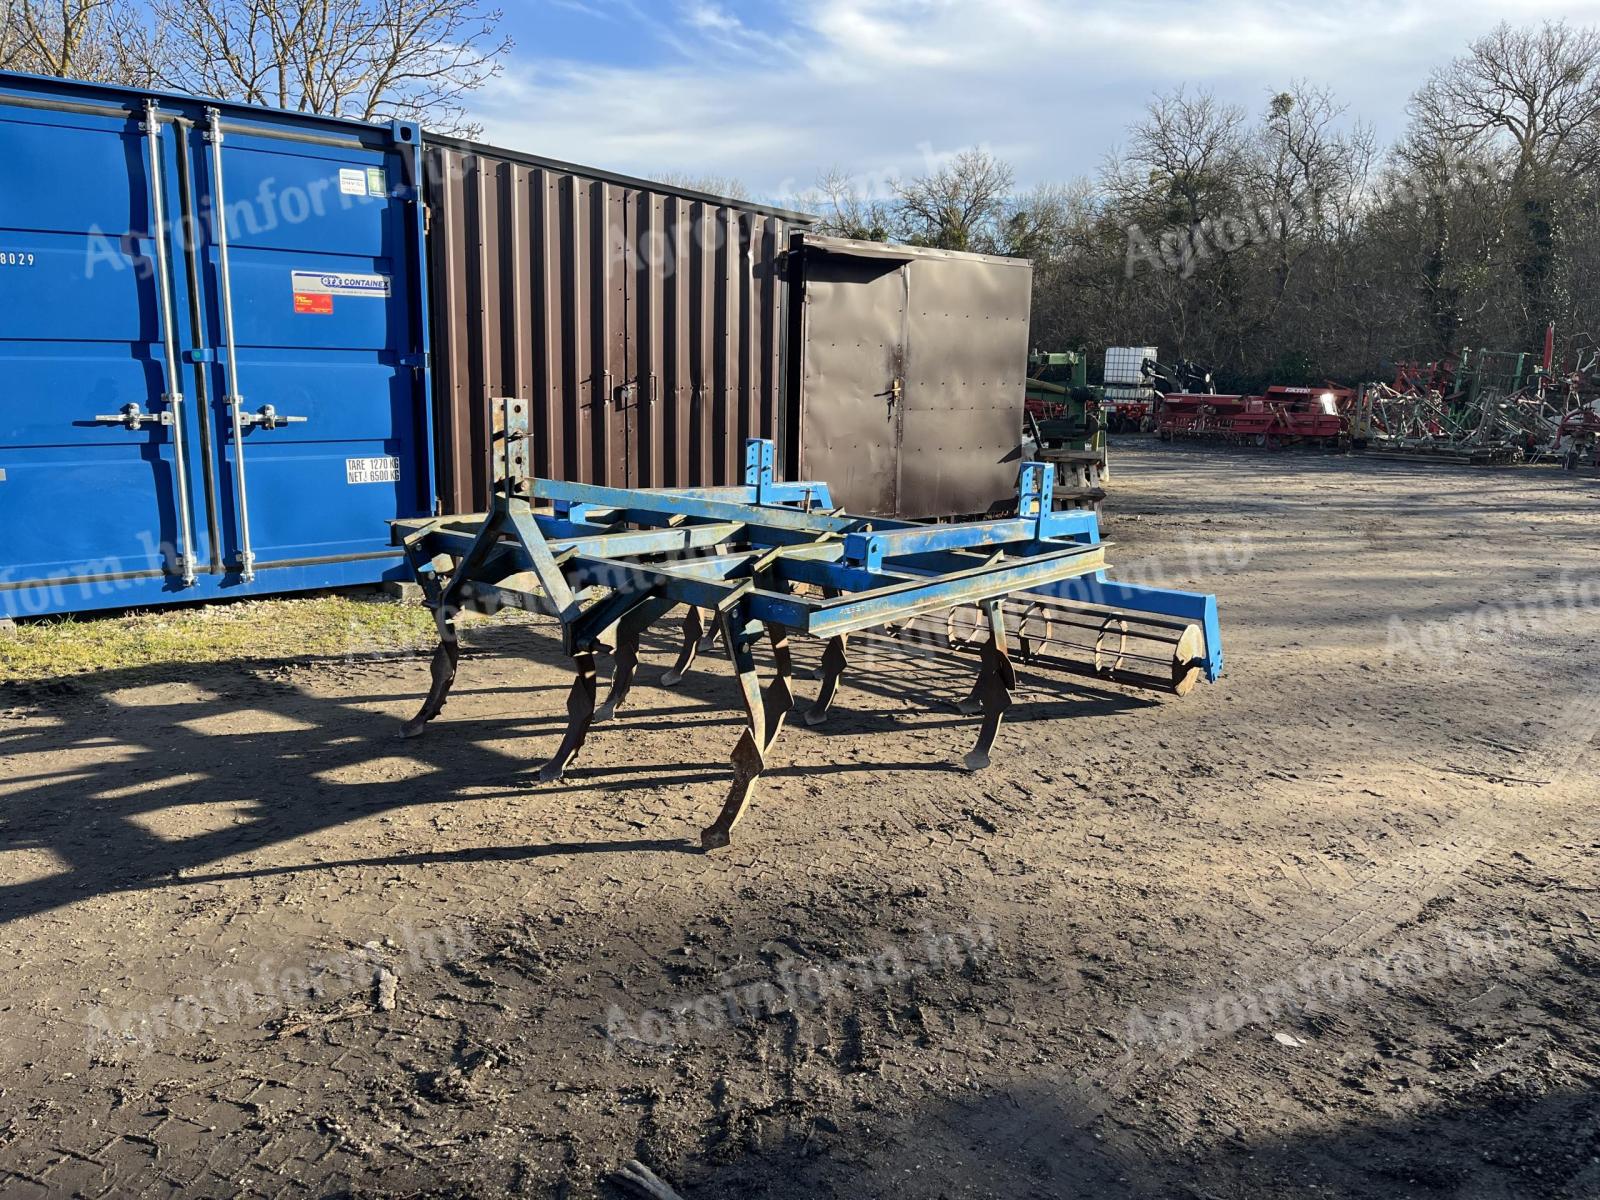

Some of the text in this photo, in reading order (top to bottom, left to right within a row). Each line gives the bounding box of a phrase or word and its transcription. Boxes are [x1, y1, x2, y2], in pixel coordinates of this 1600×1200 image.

[0, 252, 34, 266] 8029
[344, 279, 388, 287] CONTAINEX
[349, 458, 399, 471] TARE 1270 KG
[370, 471, 389, 482] 6500
[390, 470, 399, 480] KG
